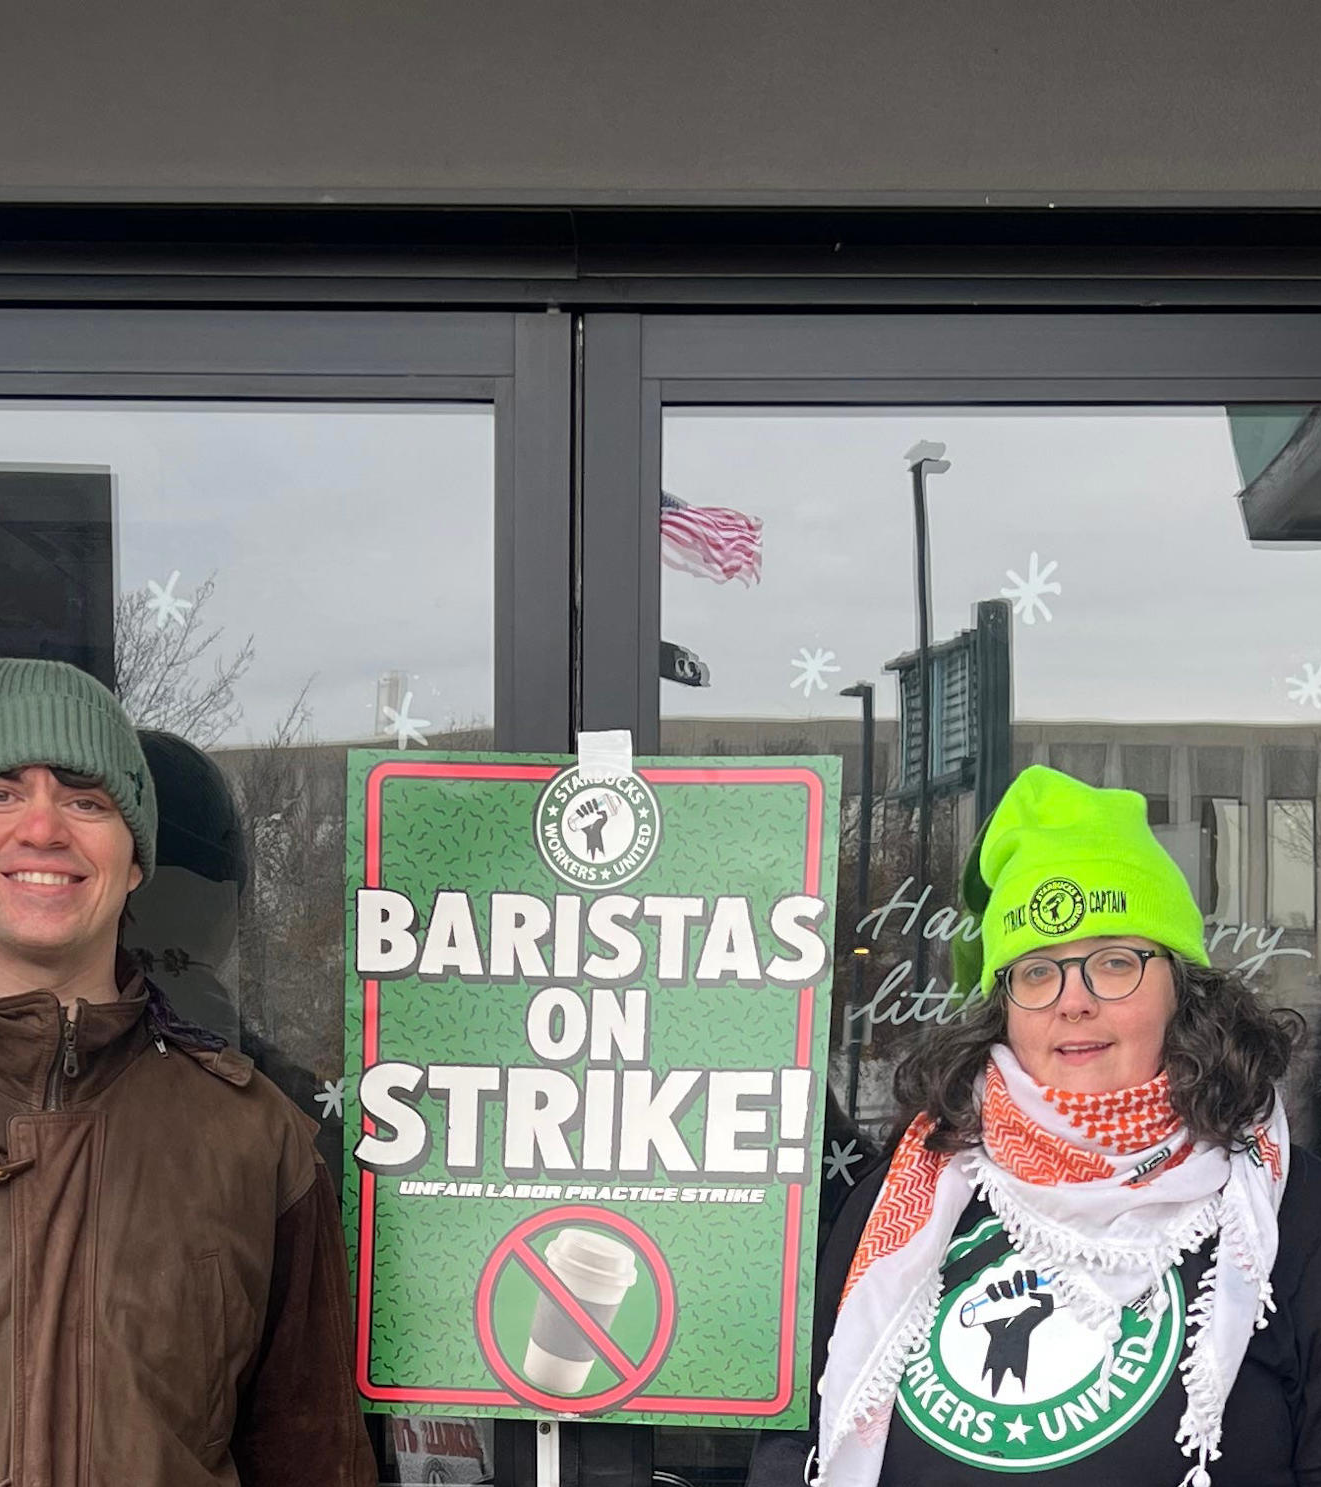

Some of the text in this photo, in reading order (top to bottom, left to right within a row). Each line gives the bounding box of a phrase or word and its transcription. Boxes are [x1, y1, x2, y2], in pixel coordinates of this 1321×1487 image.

[544, 822, 652, 880] WORKERS UNITED
[355, 889, 829, 987] BARISTAS
[856, 876, 1312, 980] Hav rry
[1089, 891, 1127, 914] CAPTAIN
[526, 986, 649, 1063] ON
[848, 959, 982, 1026] litt
[354, 1062, 813, 1183] STRIKE!
[399, 1181, 767, 1203] UNFAIR LABOR PRACTICE STRIKE
[905, 1337, 997, 1444] ORKERS
